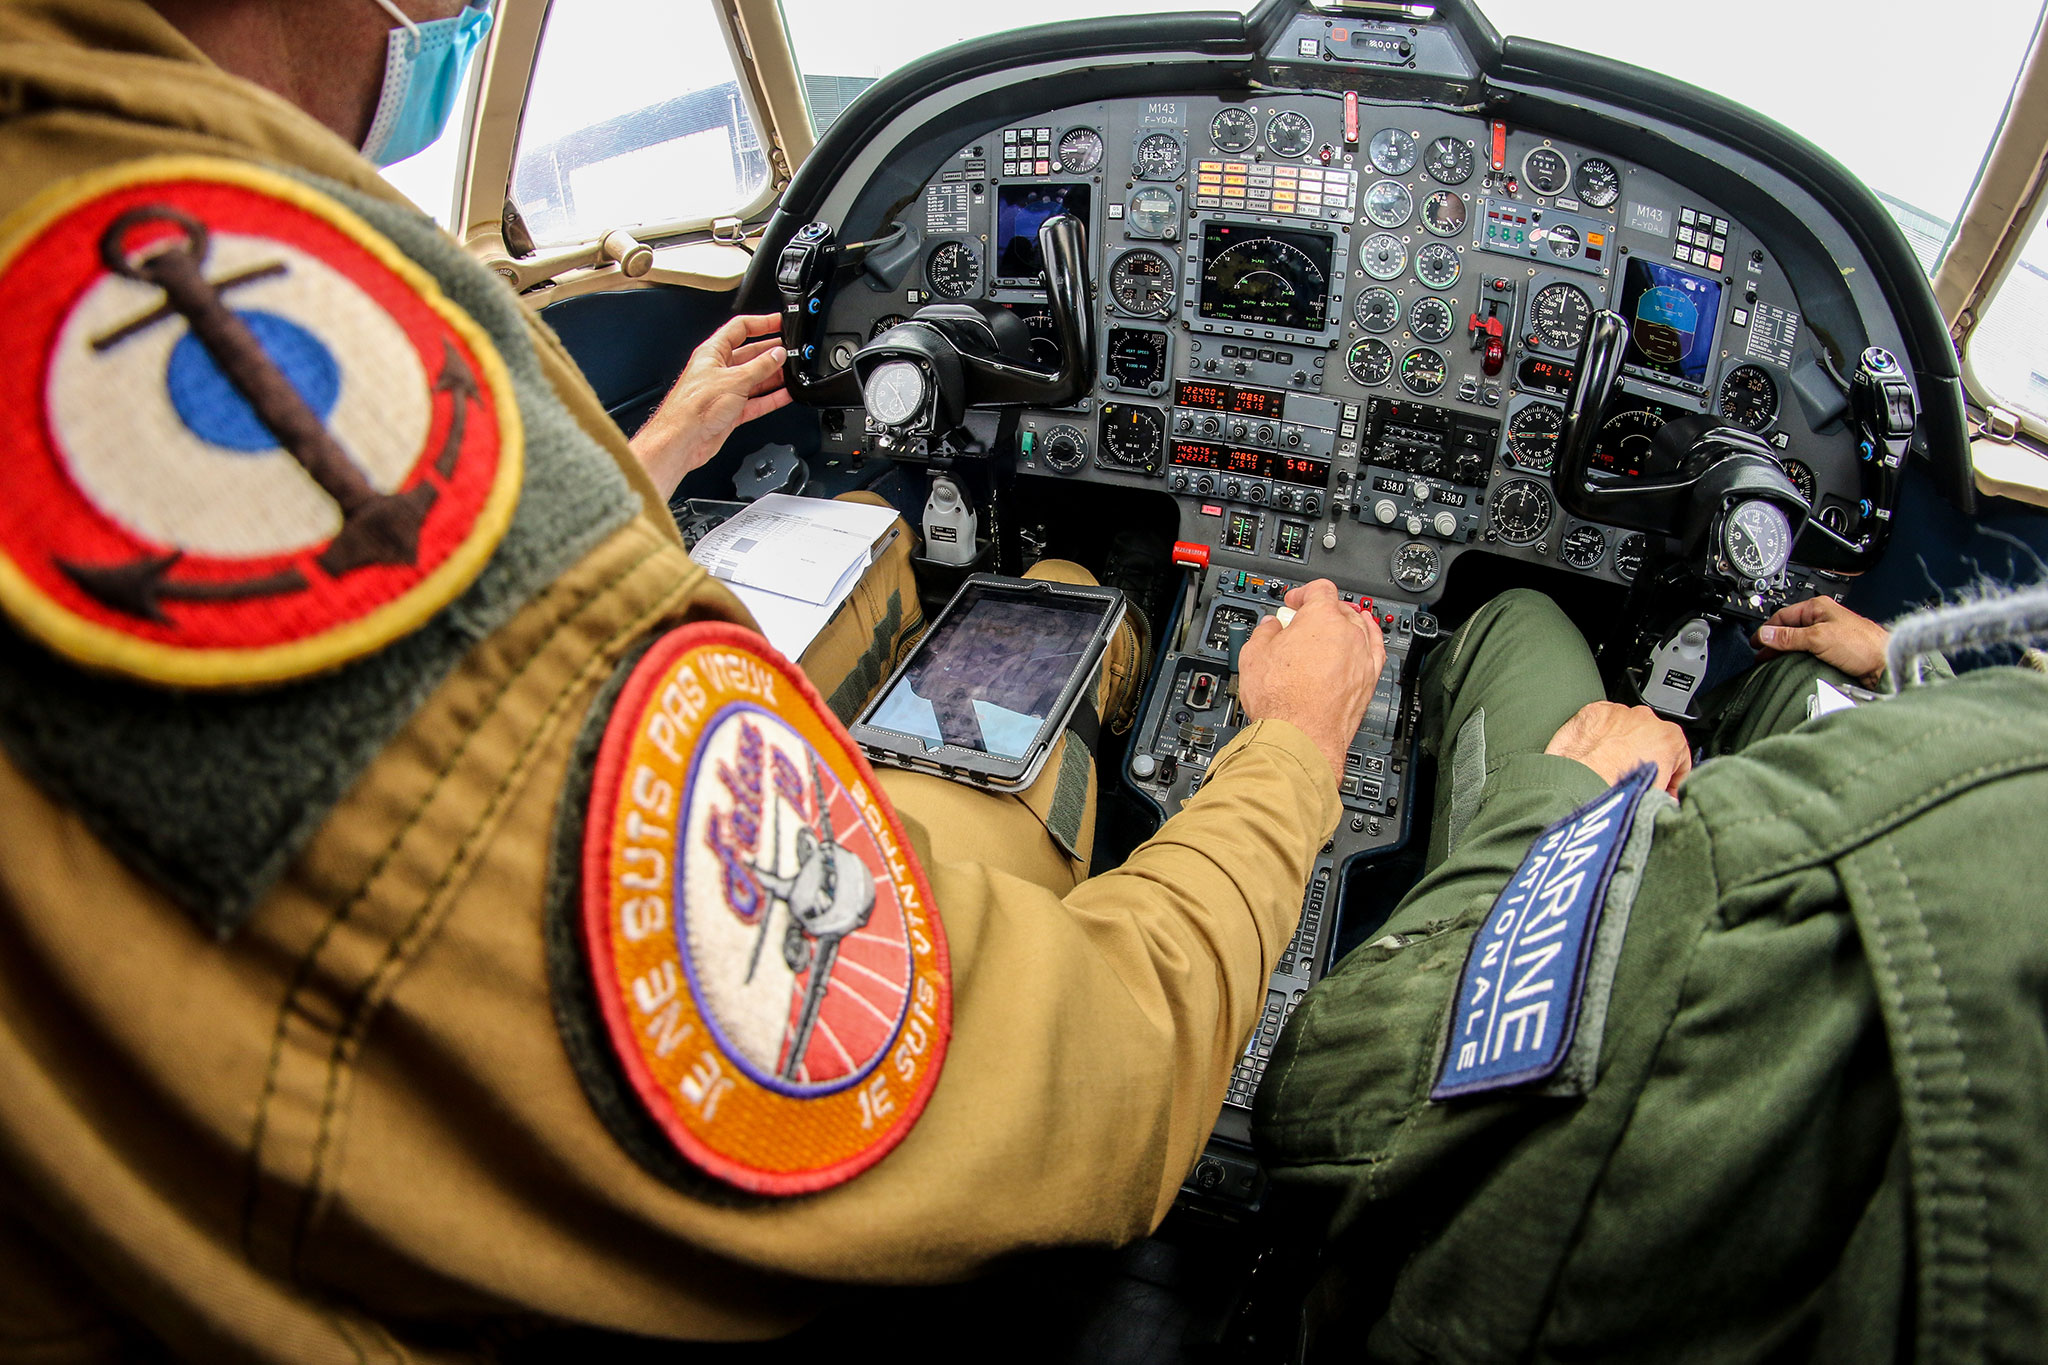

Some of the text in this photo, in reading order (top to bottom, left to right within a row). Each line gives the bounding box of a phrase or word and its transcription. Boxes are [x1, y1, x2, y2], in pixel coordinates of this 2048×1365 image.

[1148, 103, 1175, 114] M143
[1144, 116, 1178, 124] F-YDAJ
[1636, 204, 1663, 222] M143
[1556, 227, 1572, 235] FLAPS
[1631, 218, 1664, 234] F-YDAJ
[1143, 264, 1160, 274] 360
[1182, 385, 1217, 396] 122.400
[1535, 413, 1542, 421] 15
[1550, 422, 1558, 430] 21
[1466, 434, 1473, 443] 2
[1381, 479, 1405, 493] 338.0
[1441, 491, 1463, 505] 338.0
[1750, 512, 1761, 524] 12
[1734, 531, 1742, 541] 9
[1766, 538, 1775, 548] 3
[647, 665, 707, 762] PAS
[1363, 785, 1379, 793] MACH
[1492, 792, 1626, 1061] MARINE
[1456, 830, 1566, 1071] NATIONALE
[632, 958, 694, 1058] NE
[858, 1074, 895, 1129] JE
[895, 977, 938, 1077] SUIS
[1242, 1070, 1249, 1080] 5
[678, 1050, 736, 1122] JE
[1238, 1082, 1245, 1091] 8
[1235, 1094, 1242, 1103] 0
